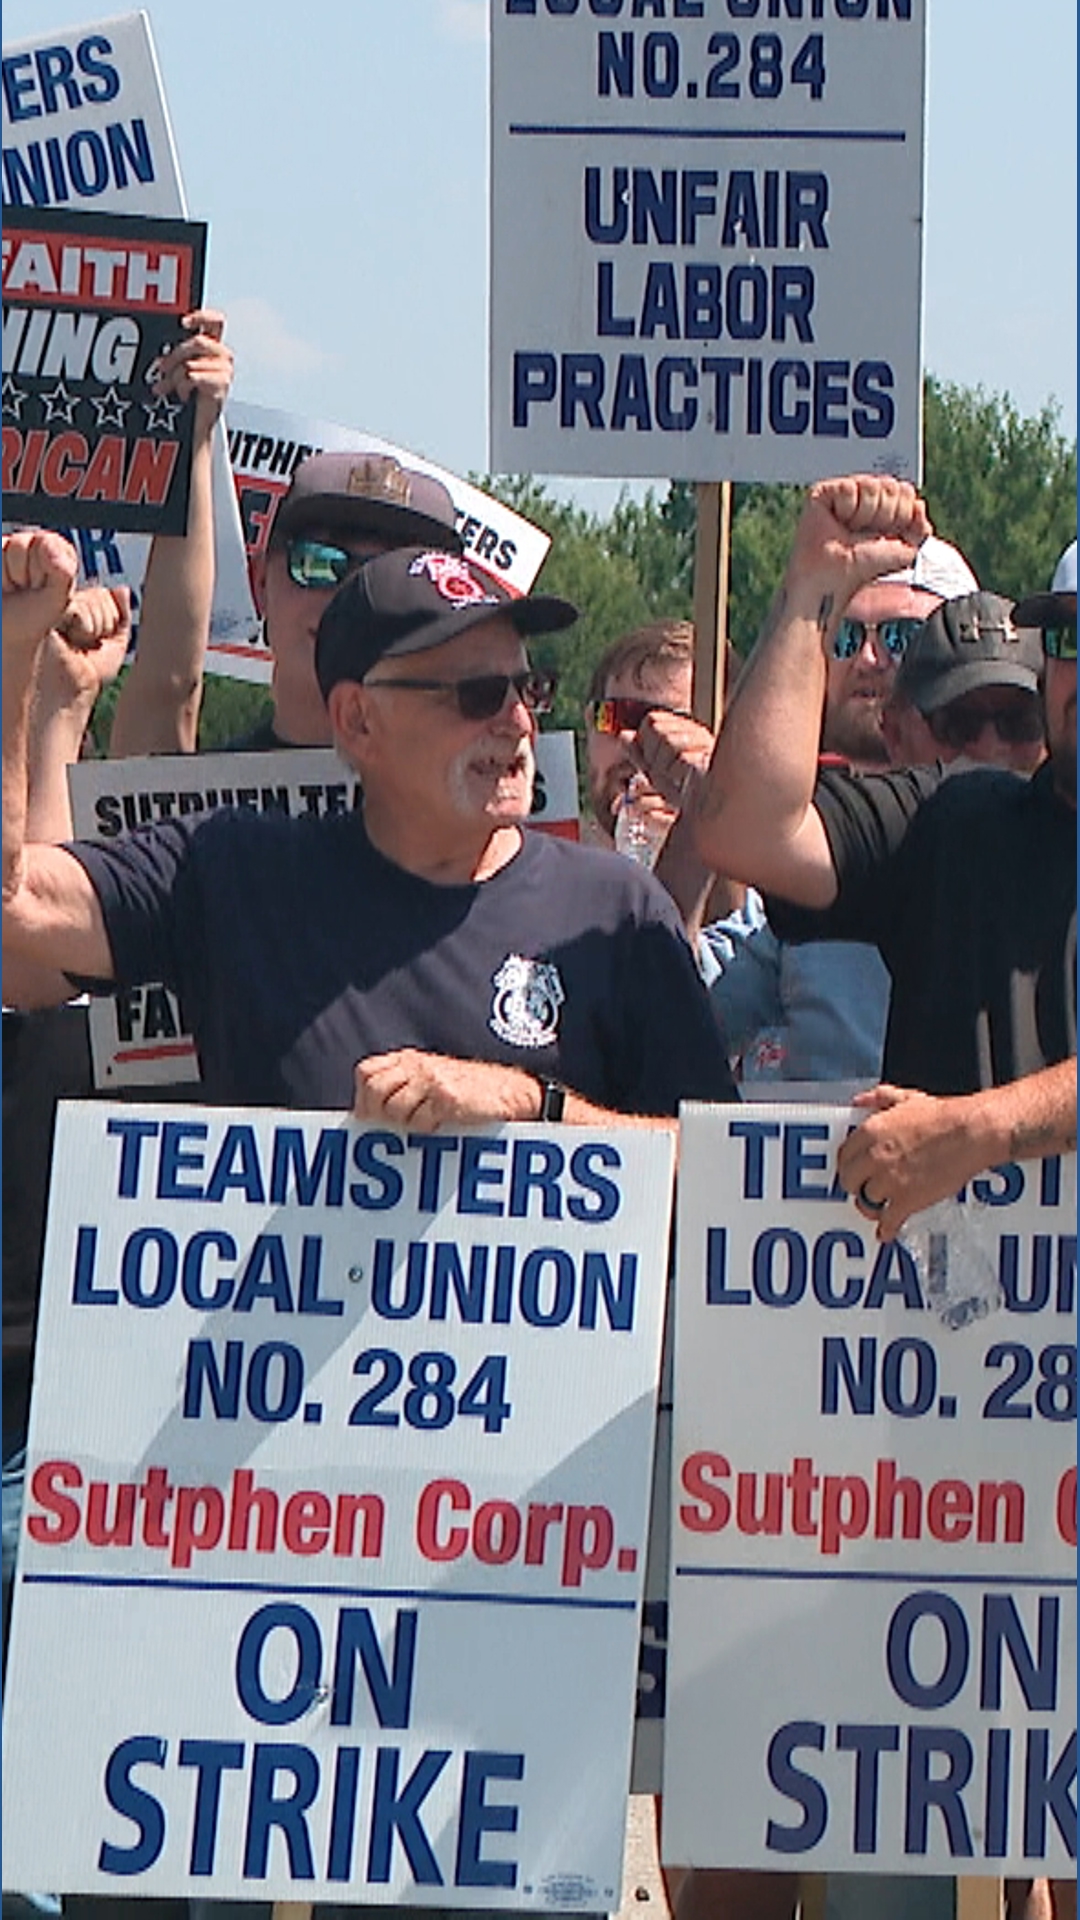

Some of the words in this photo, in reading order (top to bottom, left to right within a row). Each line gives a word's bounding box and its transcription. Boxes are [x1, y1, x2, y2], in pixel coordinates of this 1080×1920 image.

[2, 36, 120, 124] ERS
[2, 119, 155, 207] NION
[584, 166, 829, 249] UNFAIR
[596, 261, 815, 343] LABOR
[512, 350, 895, 439] PRACTICES
[106, 1119, 622, 1223] TEAMSTERS
[72, 1227, 343, 1316] LOCAL
[371, 1239, 638, 1331] UNION
[183, 1339, 322, 1423] NO.
[349, 1349, 510, 1433] 284
[820, 1337, 957, 1418] NO.
[983, 1343, 1077, 1420] 28
[27, 1460, 385, 1567] Sutphen
[415, 1479, 638, 1587] Corp.
[680, 1451, 1024, 1554] Sutphen
[235, 1601, 418, 1729] ON
[886, 1590, 1060, 1711] ON
[98, 1735, 525, 1888] STRIKE
